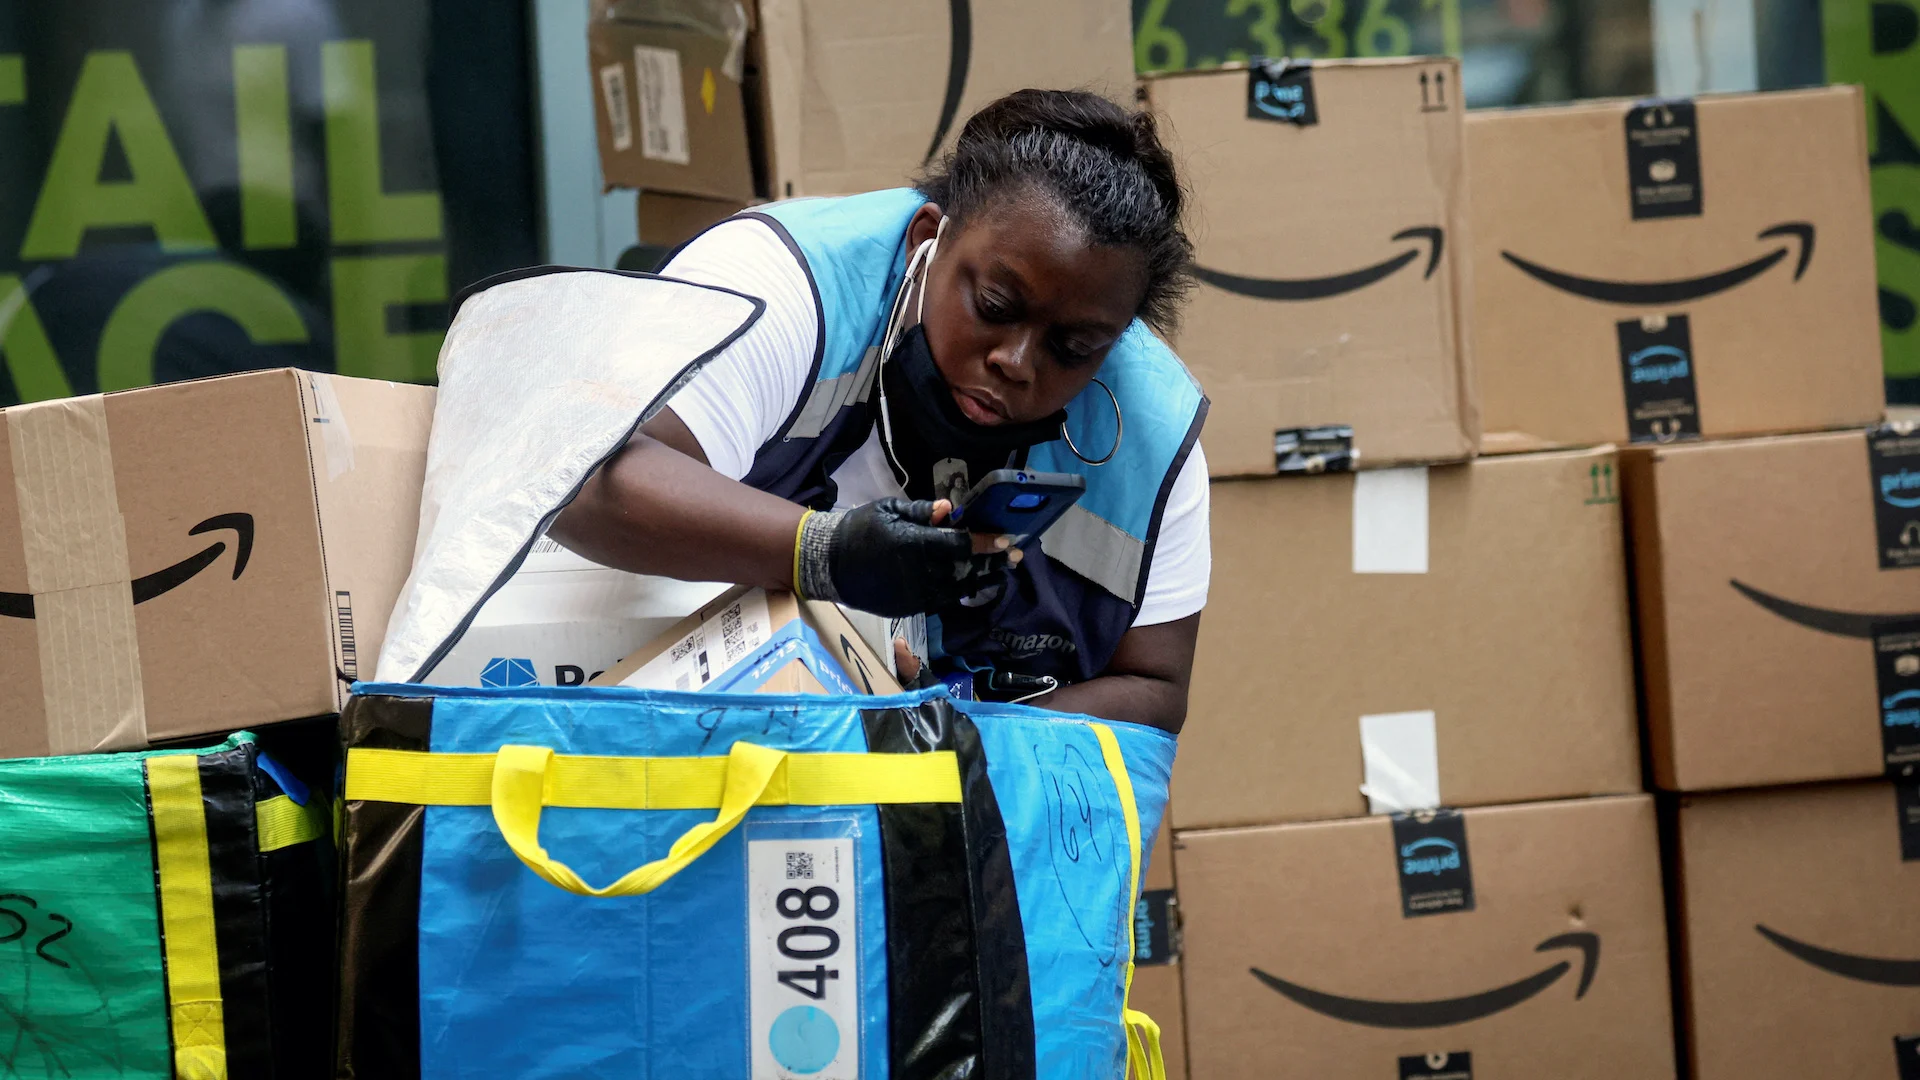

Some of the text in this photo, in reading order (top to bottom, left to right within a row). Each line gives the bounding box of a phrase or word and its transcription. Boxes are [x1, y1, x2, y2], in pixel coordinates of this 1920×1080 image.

[0, 39, 444, 260] AIL
[1630, 357, 1689, 384] prime
[1881, 467, 1920, 496] prim
[988, 627, 1077, 653] amazon
[751, 639, 797, 679] 12-13
[1402, 850, 1461, 876] prime
[776, 885, 840, 1000] 408
[1136, 899, 1154, 960] prime
